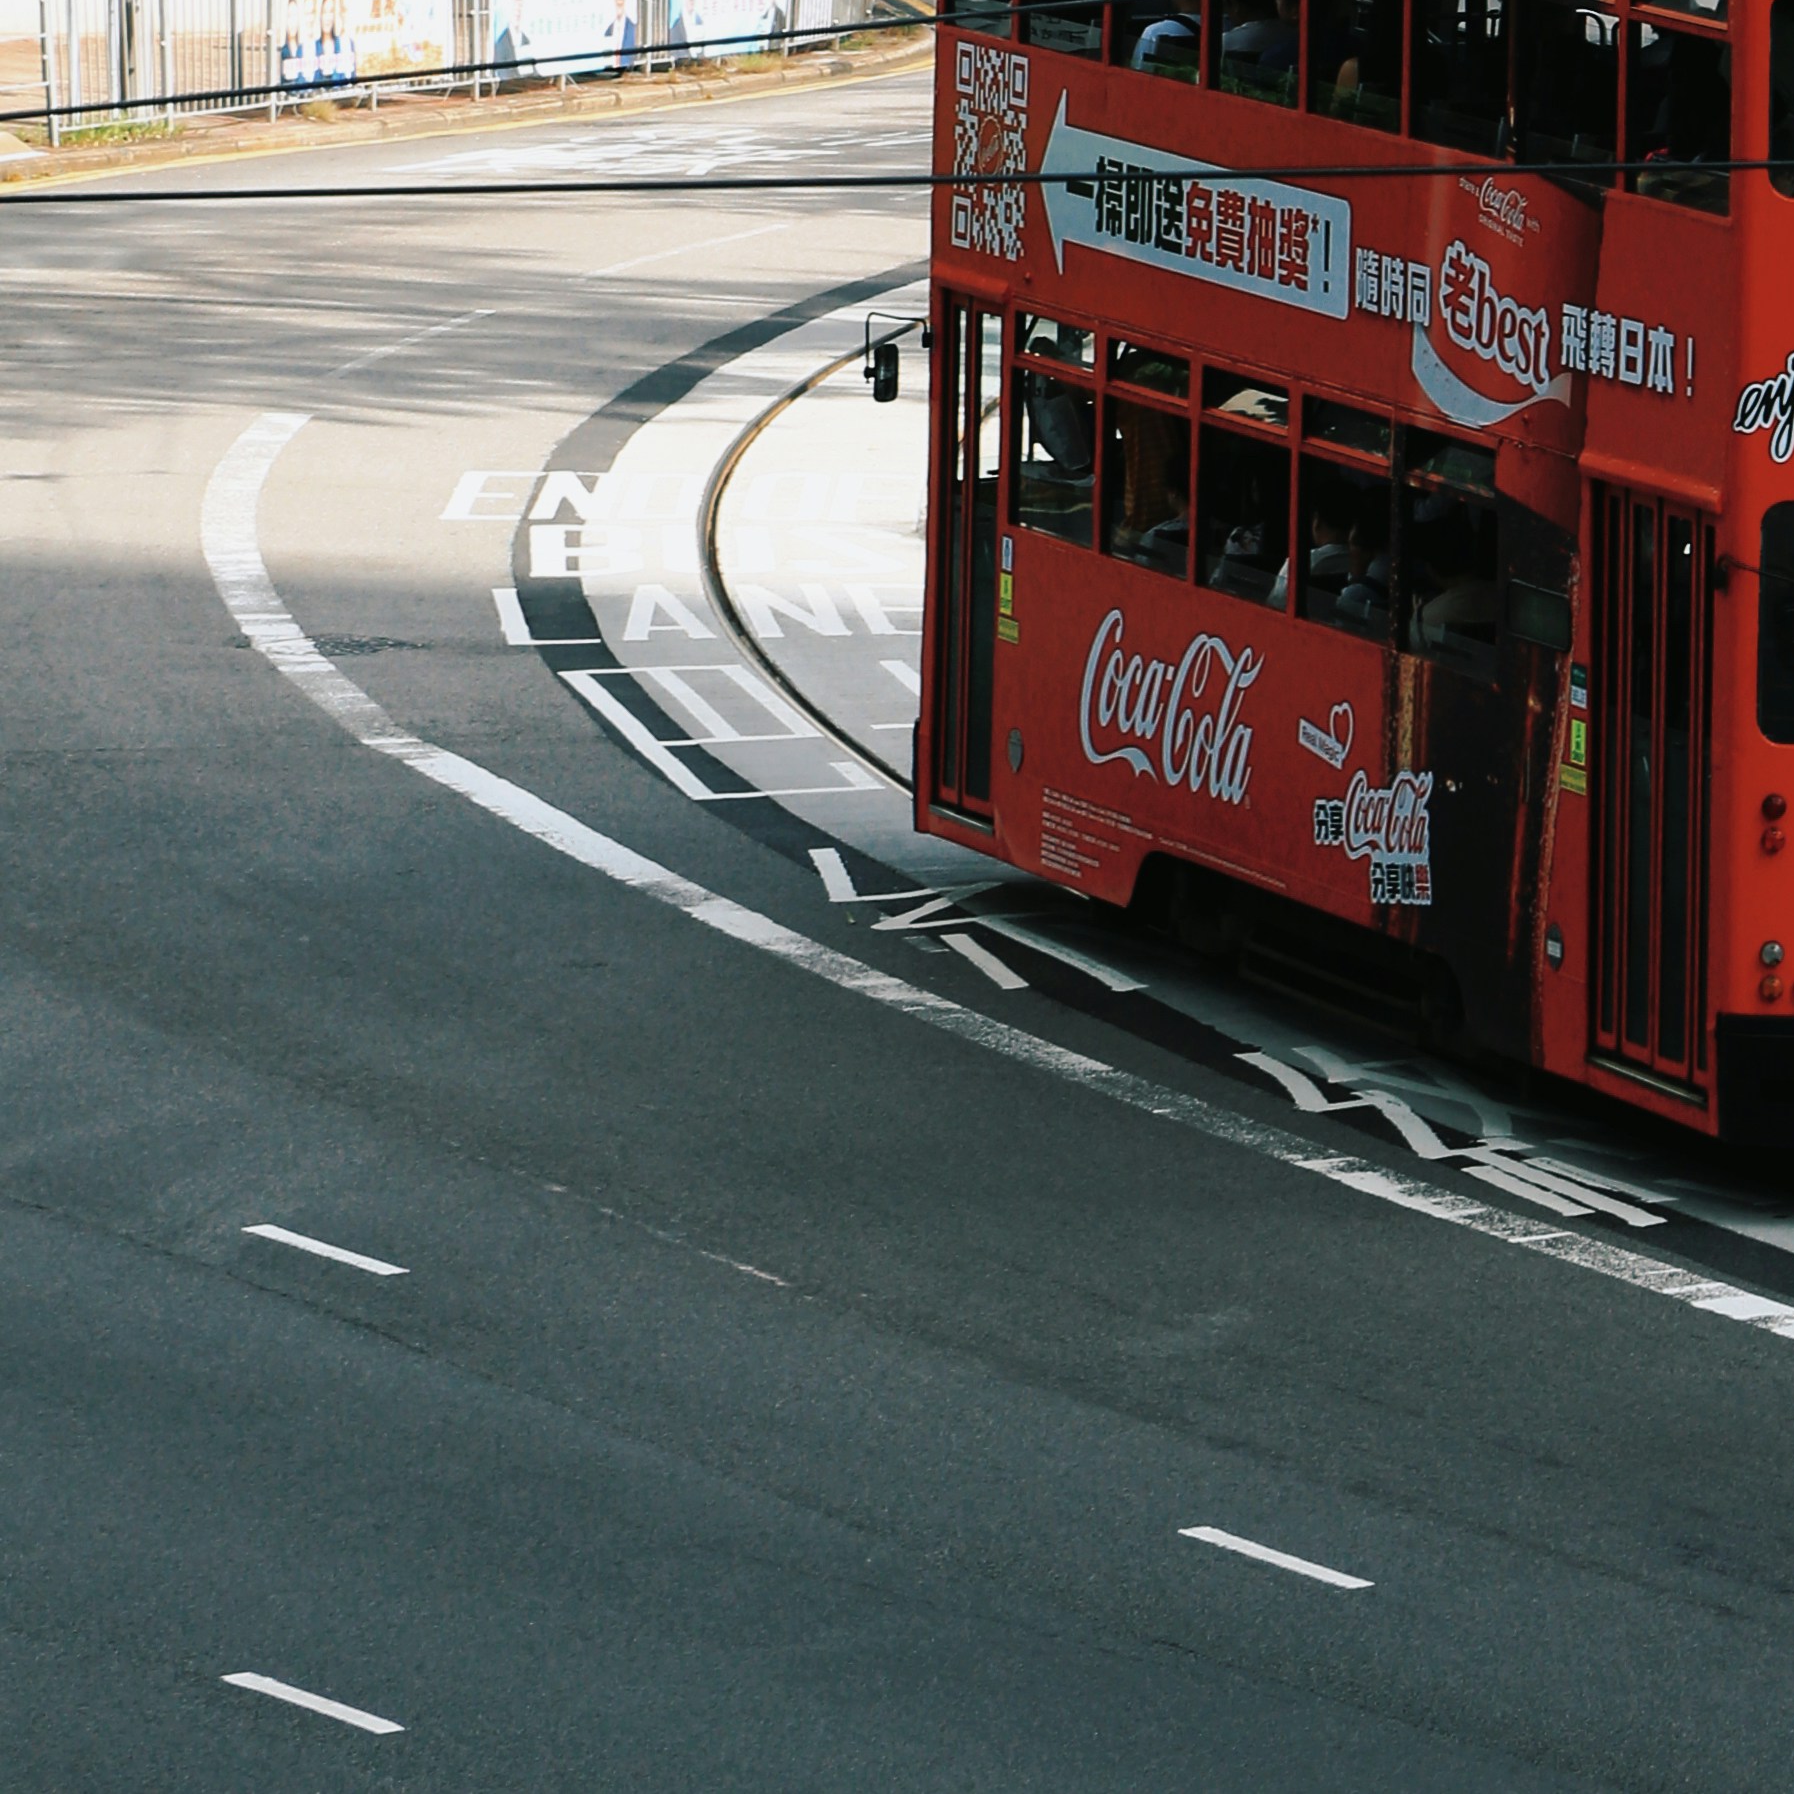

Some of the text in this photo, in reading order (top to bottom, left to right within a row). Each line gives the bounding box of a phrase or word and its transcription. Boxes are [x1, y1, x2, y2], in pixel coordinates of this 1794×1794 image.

[1479, 176, 1529, 232] Coca-Cola
[1355, 246, 1432, 327] 隨時同
[529, 523, 922, 577] BUS
[1080, 609, 1265, 806] Coca-Cola
[1314, 772, 1433, 858] 分享 Coca-Cola
[1370, 861, 1431, 903] 分享快樂
